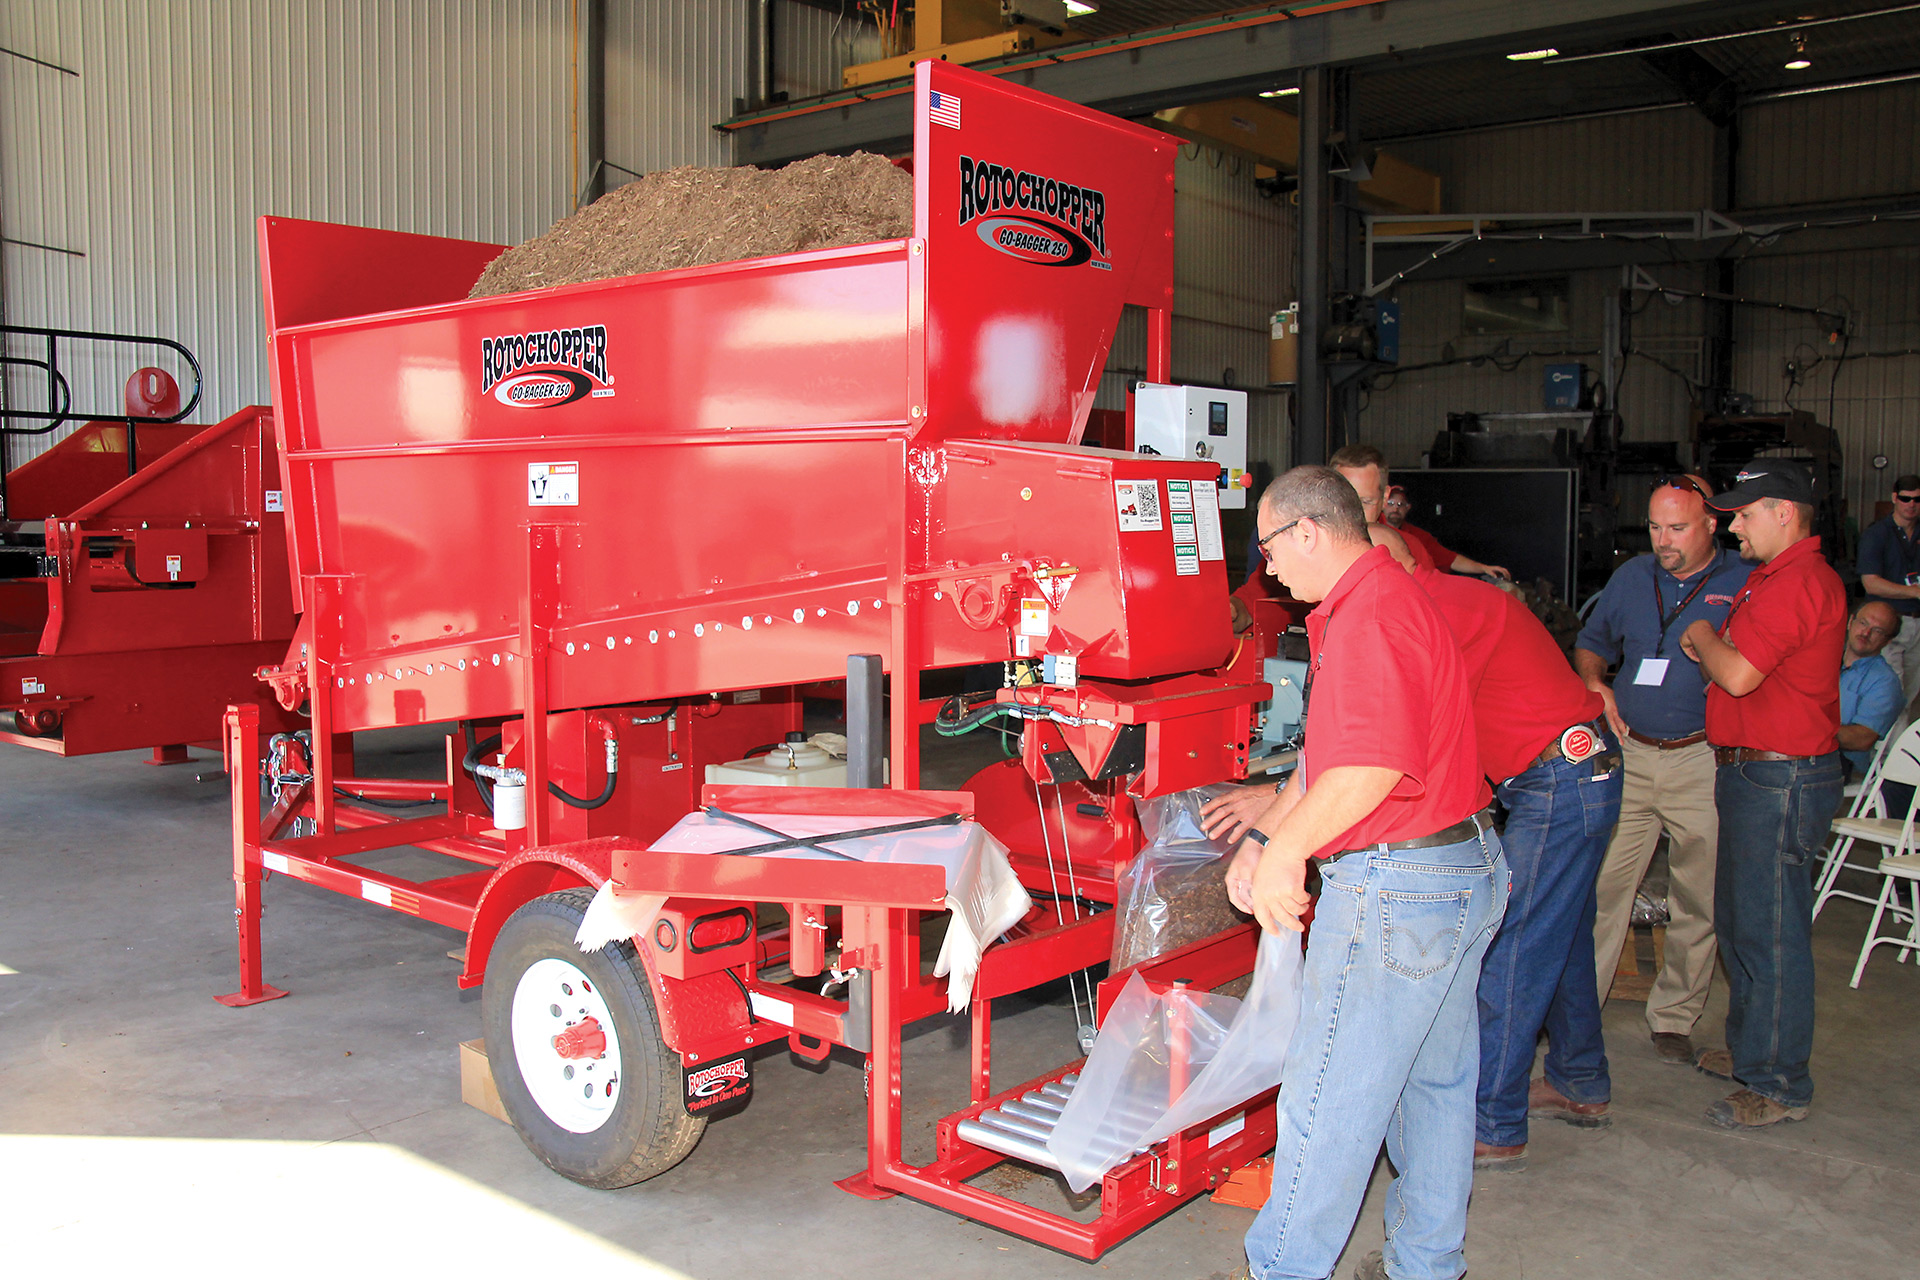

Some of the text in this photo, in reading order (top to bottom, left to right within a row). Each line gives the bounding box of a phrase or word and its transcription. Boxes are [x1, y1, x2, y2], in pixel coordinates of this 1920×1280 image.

[960, 155, 1106, 258] ROTOCHOPPER
[1000, 228, 1068, 258] GO-BAGGER 250
[482, 324, 608, 394] ROTOCHOPPER
[512, 382, 571, 400] GO-BAGGER 250
[688, 1058, 745, 1096] ROTOCHOPPER
[720, 1091, 731, 1102] One
